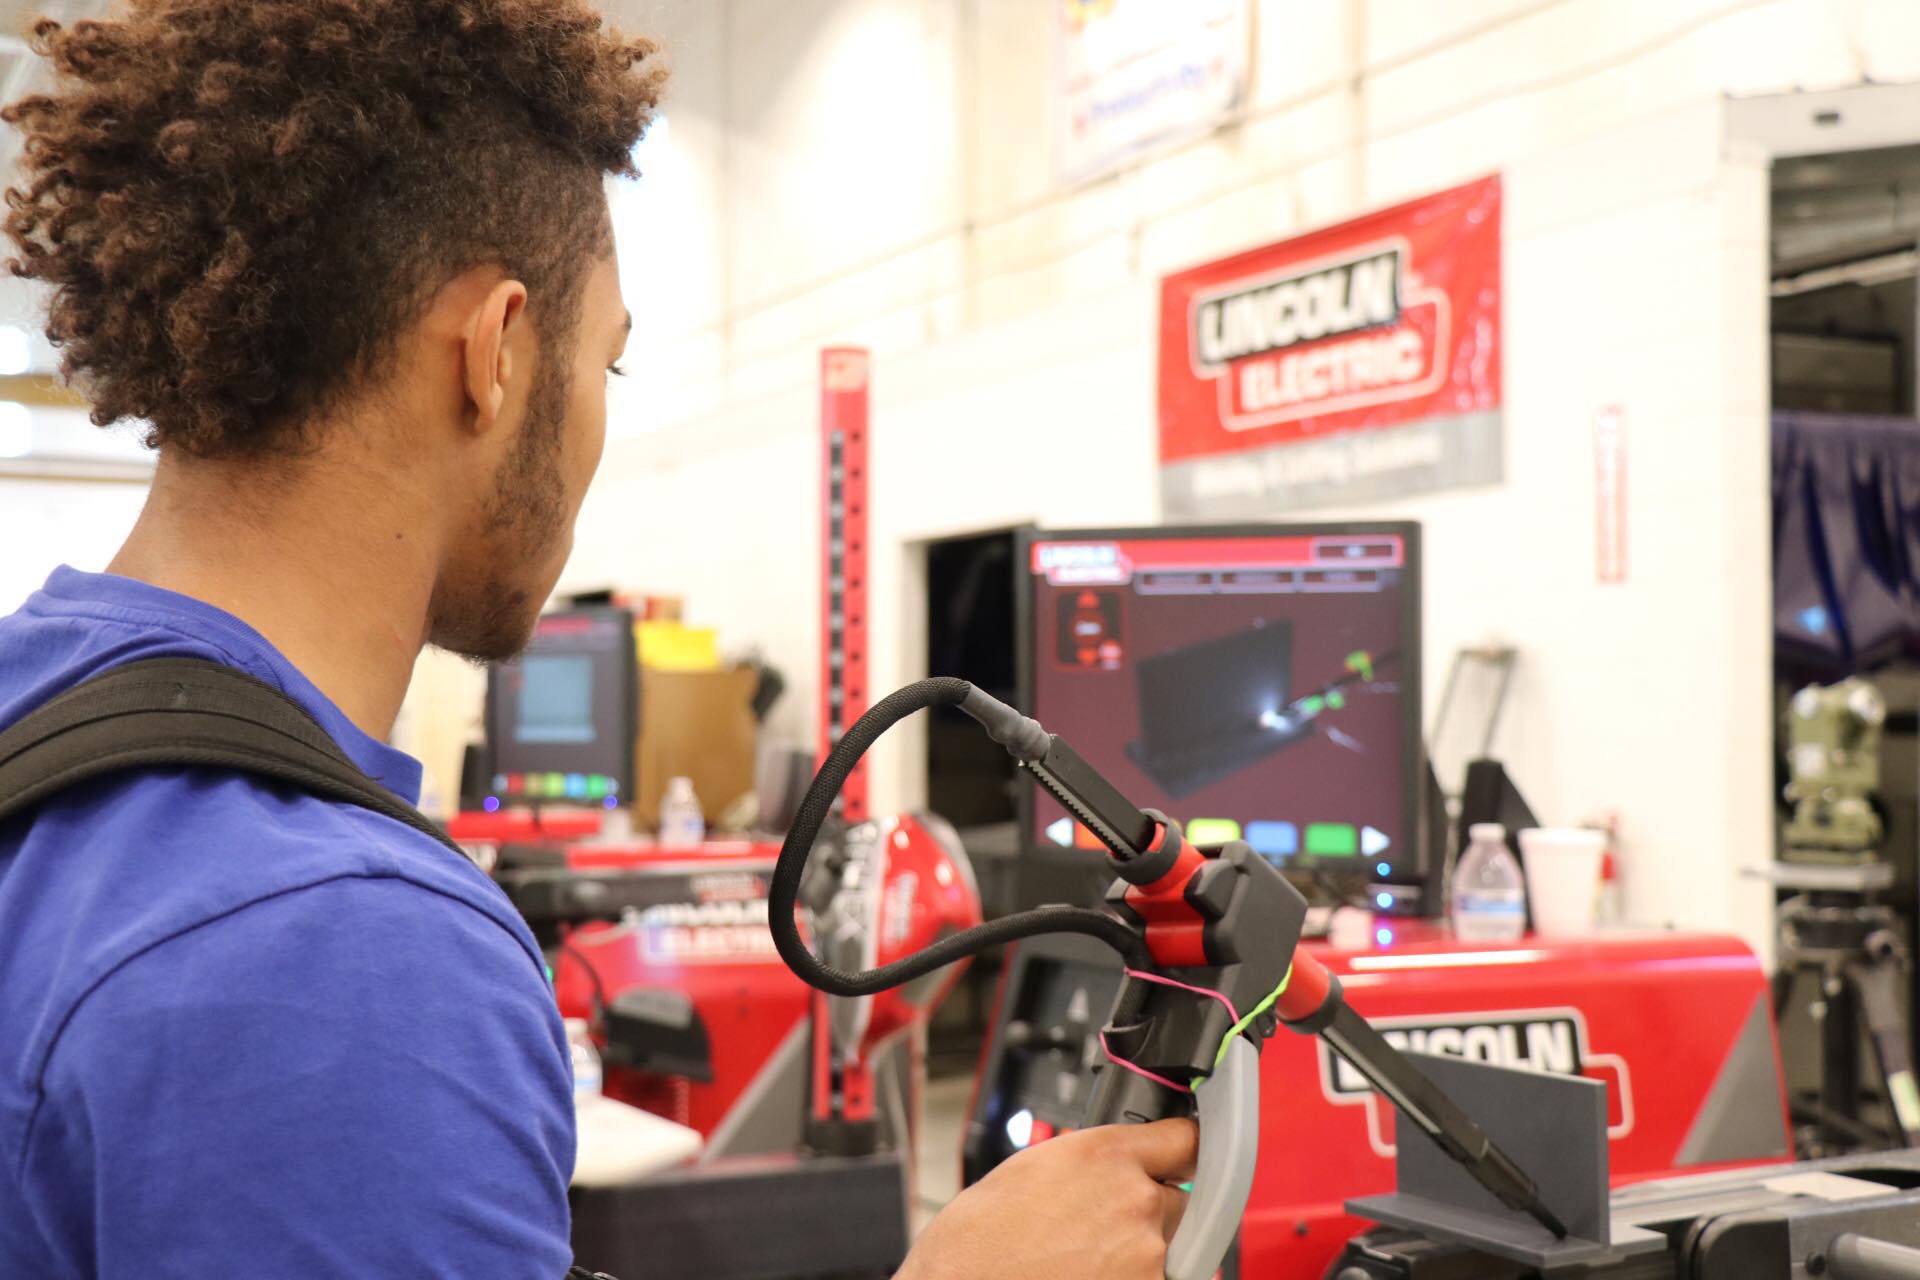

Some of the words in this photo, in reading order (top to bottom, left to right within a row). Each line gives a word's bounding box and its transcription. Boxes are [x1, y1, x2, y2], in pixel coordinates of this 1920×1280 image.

[1201, 253, 1396, 364] LINCOLN
[1240, 331, 1422, 412] ELECTRIC
[1336, 1021, 1574, 1089] LCOLN
